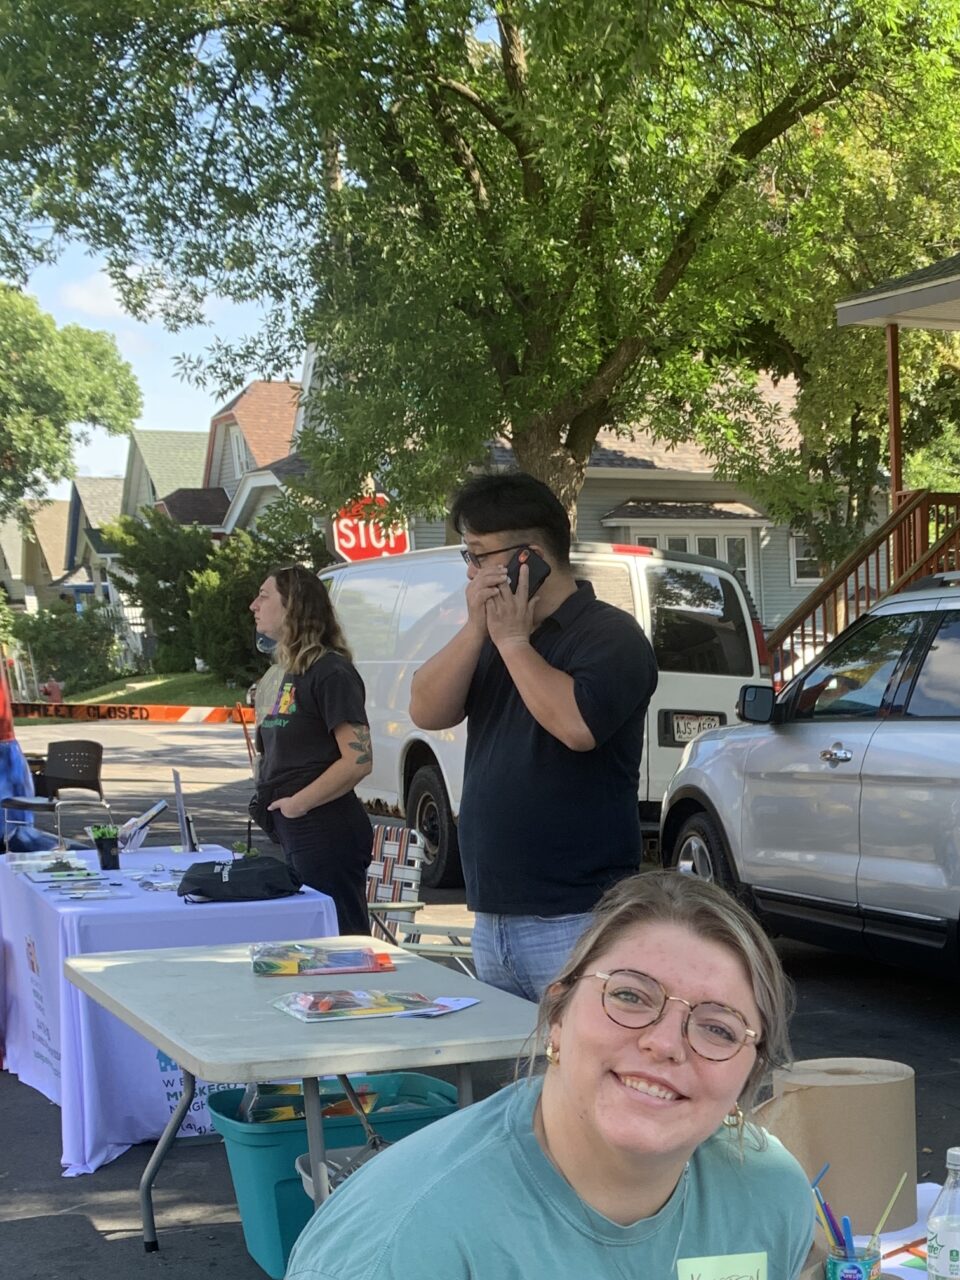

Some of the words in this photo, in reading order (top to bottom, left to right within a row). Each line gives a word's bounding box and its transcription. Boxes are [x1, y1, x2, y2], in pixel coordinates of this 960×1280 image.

[339, 518, 403, 549] STOP
[86, 705, 150, 721] CLOSED
[166, 1083, 237, 1101] MSKEGO
